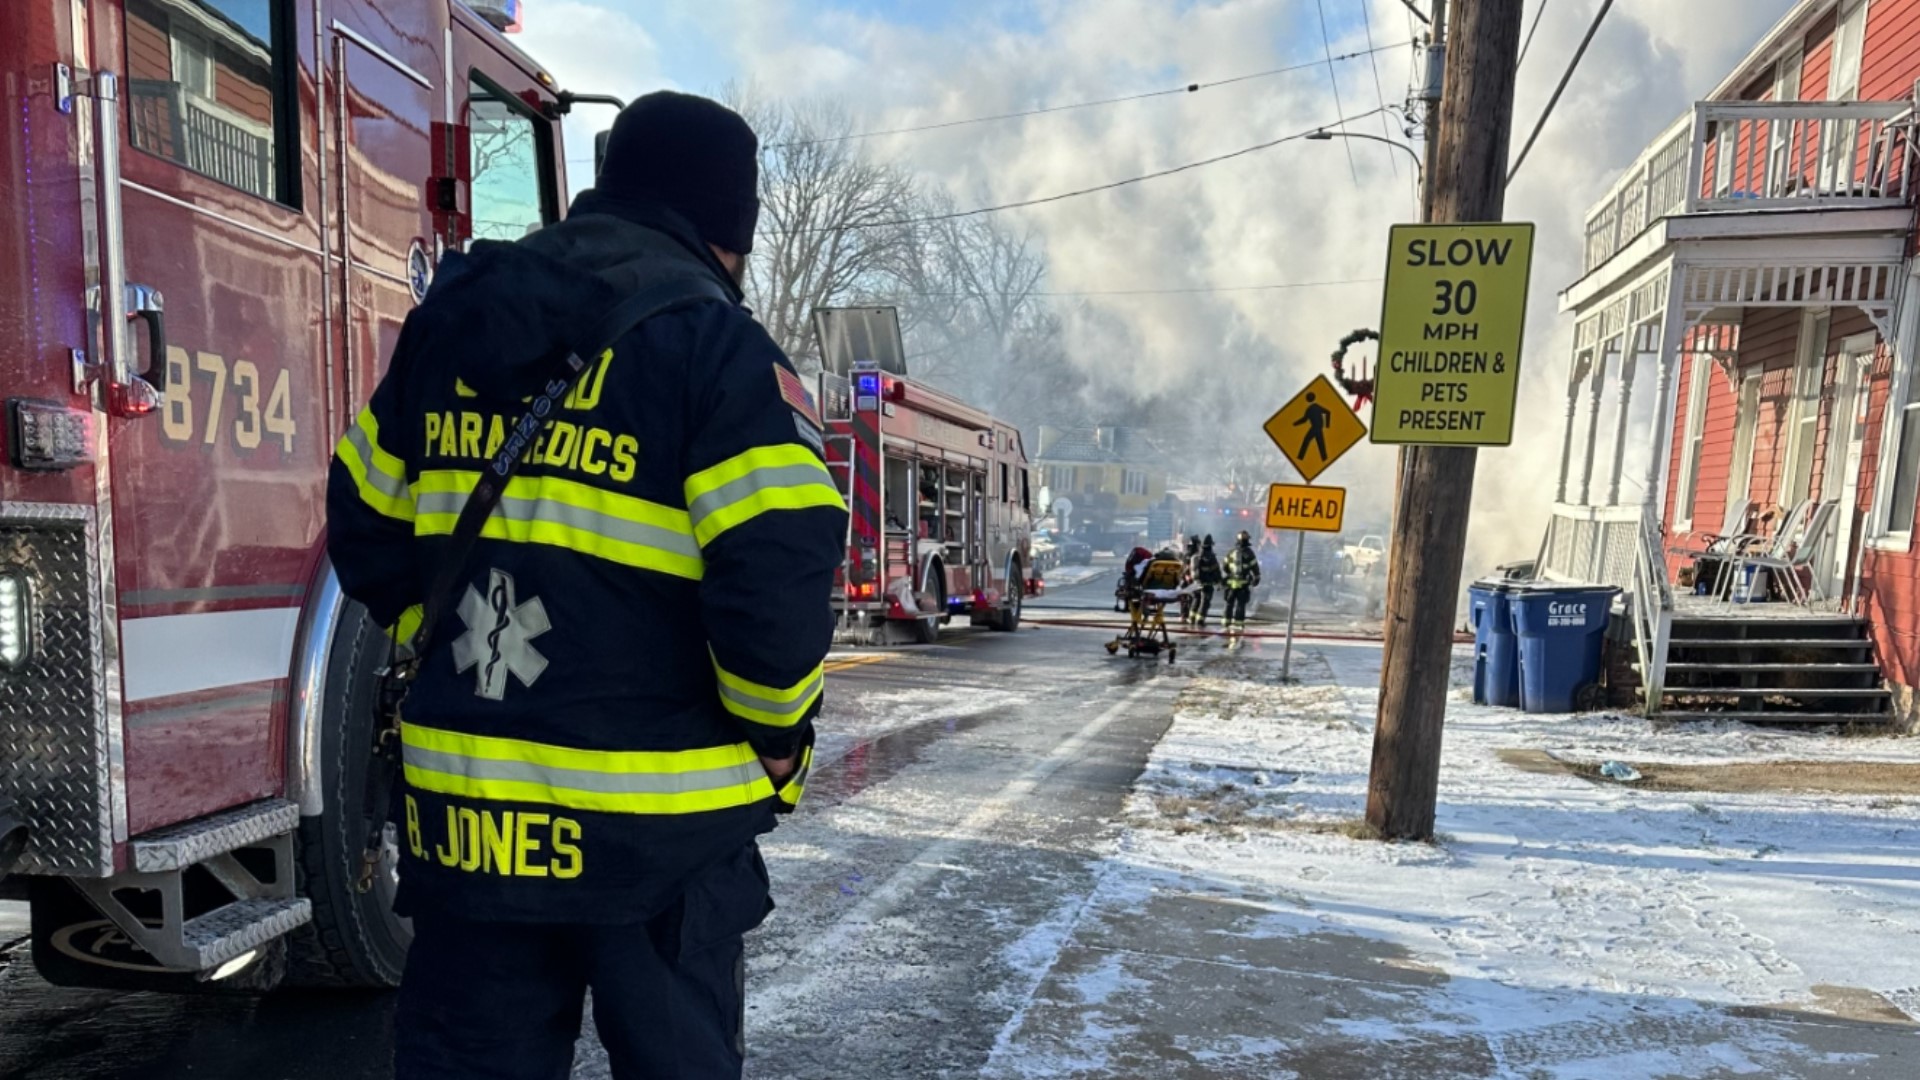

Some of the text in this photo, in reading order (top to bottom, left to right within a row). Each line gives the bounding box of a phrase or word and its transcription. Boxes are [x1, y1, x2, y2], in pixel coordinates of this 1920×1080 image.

[1406, 238, 1513, 267] SLOW
[1431, 279, 1478, 316] 30
[1422, 322, 1479, 341] MPH
[1390, 351, 1506, 374] CHILDREN &
[162, 344, 297, 453] 8734
[1420, 382, 1469, 403] PETS
[1398, 409, 1486, 431] PRESENT
[424, 410, 639, 483] PARAEDICS
[1273, 496, 1339, 520] AHEAD
[1548, 600, 1587, 615] Grace
[404, 793, 583, 880] B. JONES
